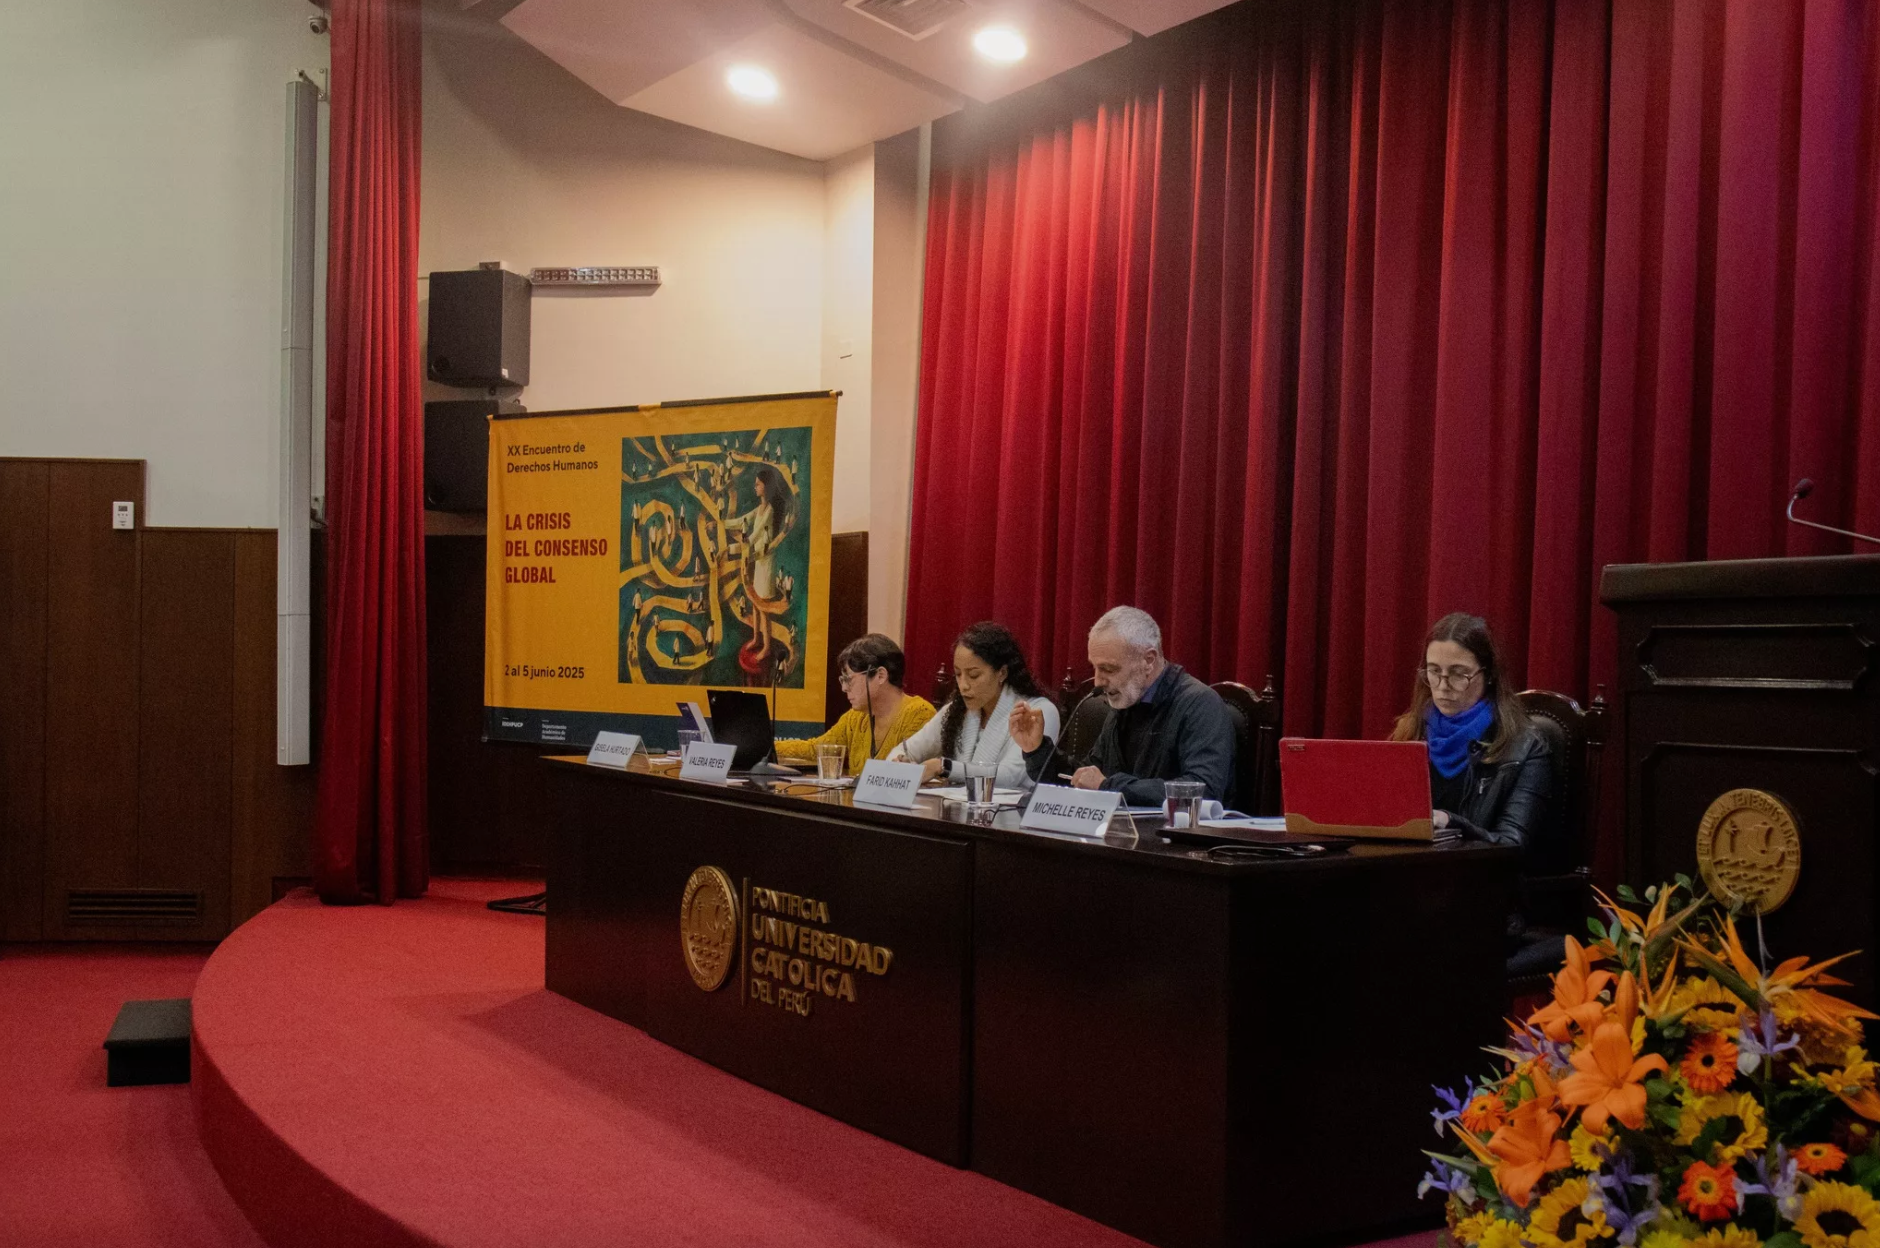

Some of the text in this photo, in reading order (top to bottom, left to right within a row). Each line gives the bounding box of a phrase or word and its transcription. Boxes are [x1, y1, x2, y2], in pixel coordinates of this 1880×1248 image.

[507, 442, 586, 457] XX Encuentro de
[507, 460, 599, 473] Derechos Humanos
[505, 512, 571, 531] LA CRISIS
[505, 538, 608, 557] DEL CONSENSO
[505, 566, 556, 584] GLOBAL
[505, 664, 585, 680] 2 al 5 junio 2025
[688, 756, 726, 769] VALERIA REYES
[866, 774, 911, 791] FARID KAHHAT
[1032, 801, 1107, 822] MICHELLE REYES
[752, 886, 829, 924] PONTIFICIA
[752, 912, 893, 976] UNIVERSIDAD
[752, 977, 811, 1017] DEL PERÚ
